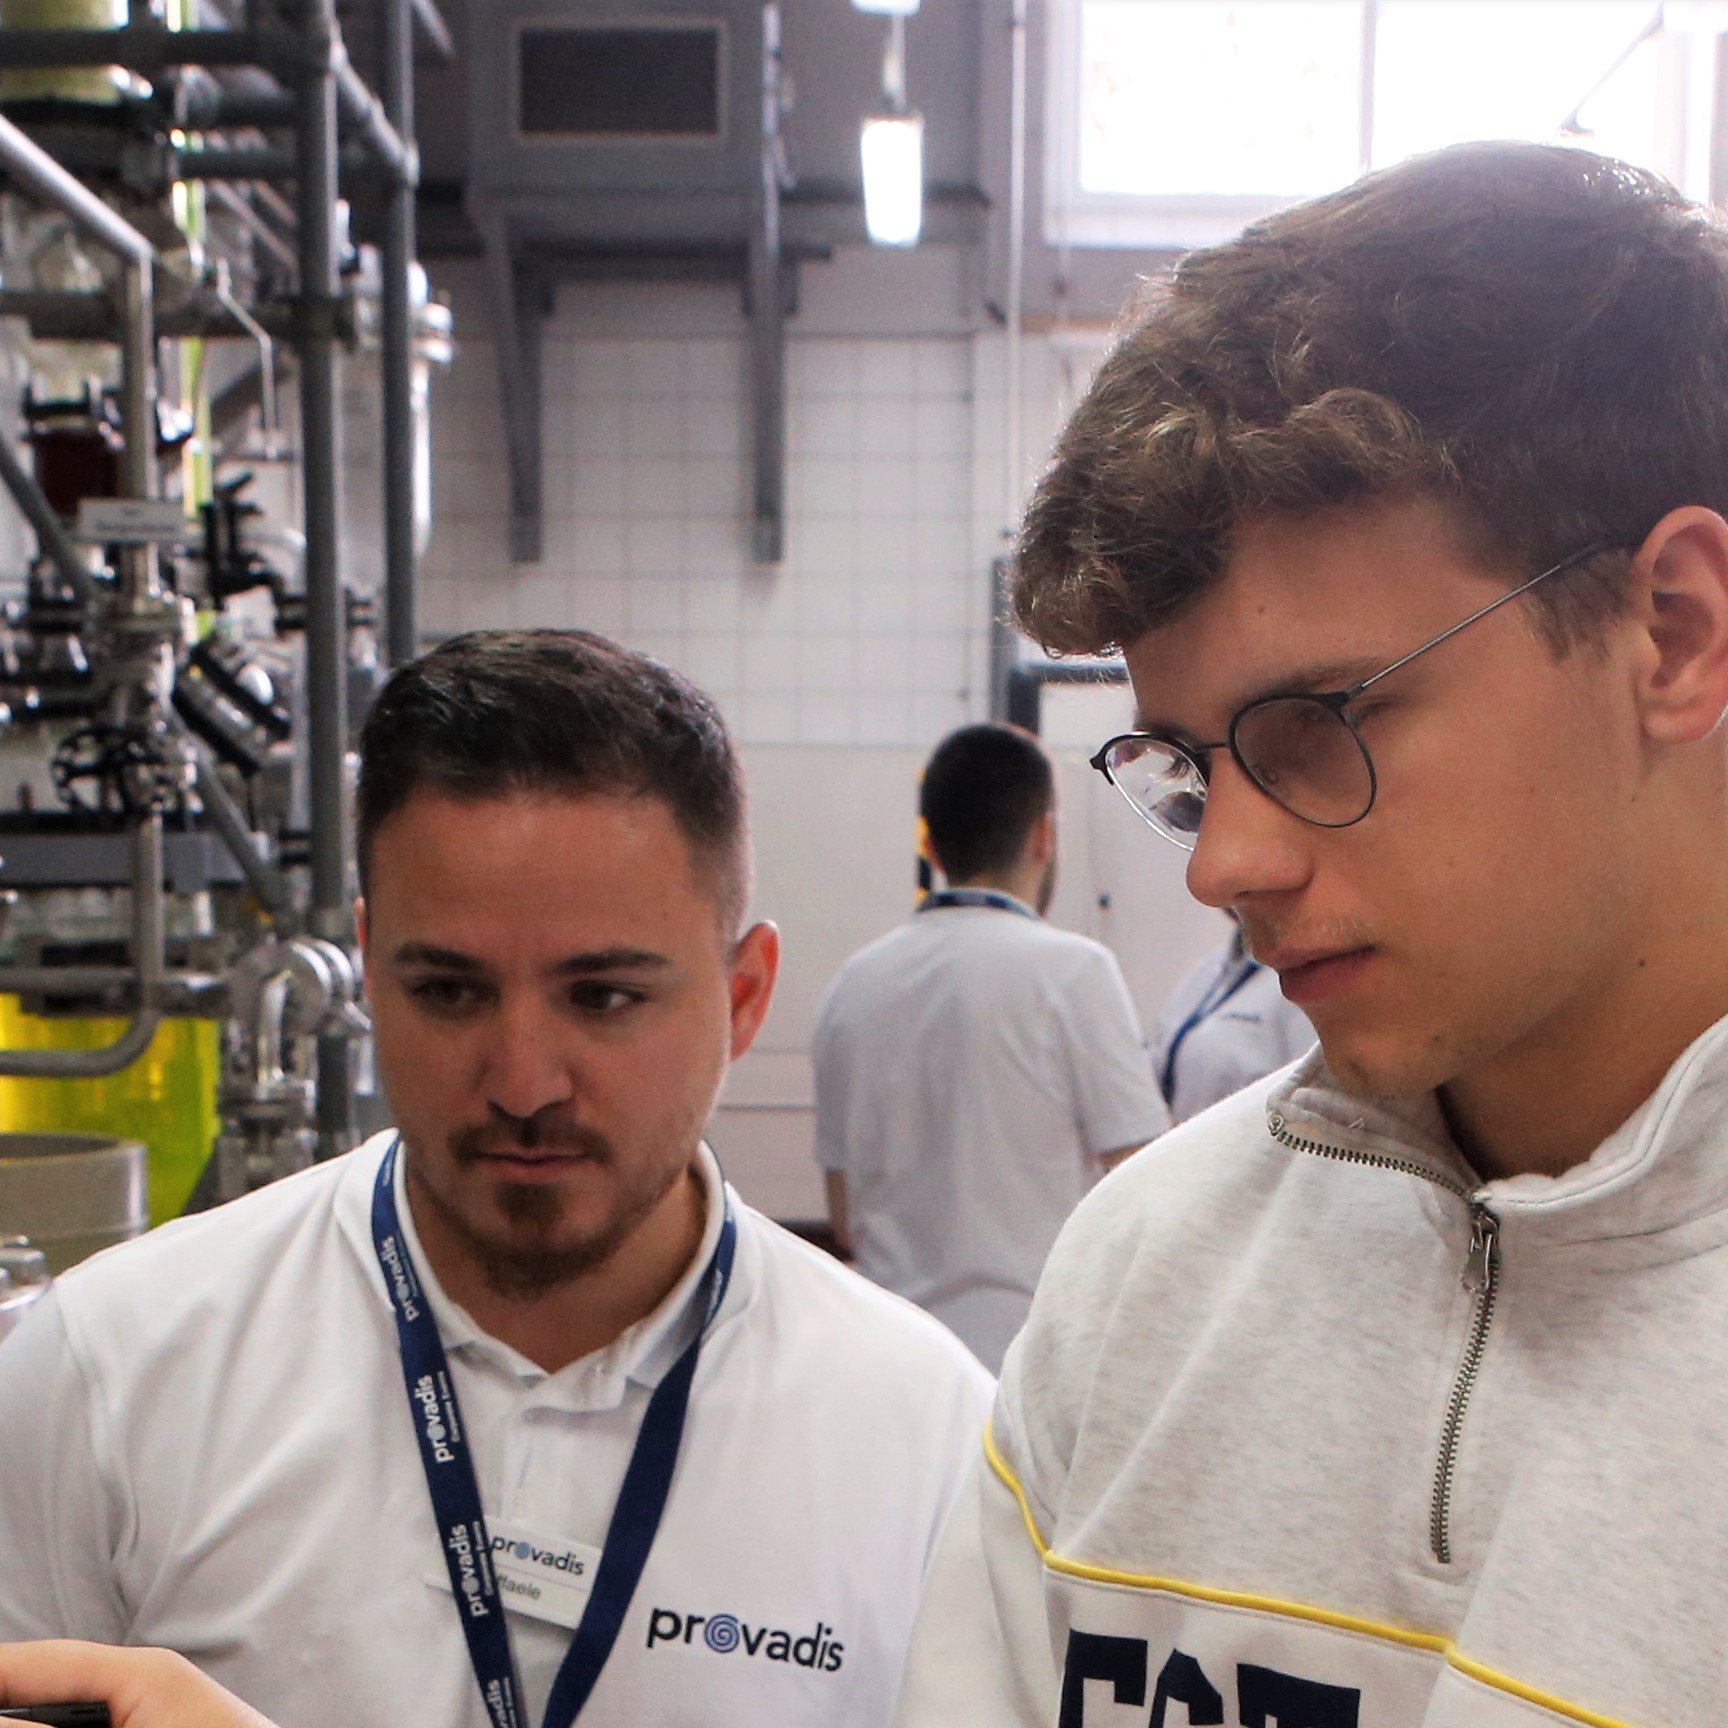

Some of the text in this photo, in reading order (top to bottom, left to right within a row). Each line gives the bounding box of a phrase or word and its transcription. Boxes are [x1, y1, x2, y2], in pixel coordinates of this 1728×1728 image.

[380, 1236, 420, 1322] provadis
[415, 1375, 454, 1463] provadis
[449, 1523, 489, 1617] provadis
[489, 1536, 584, 1576] provadis
[646, 1607, 844, 1672] provadis
